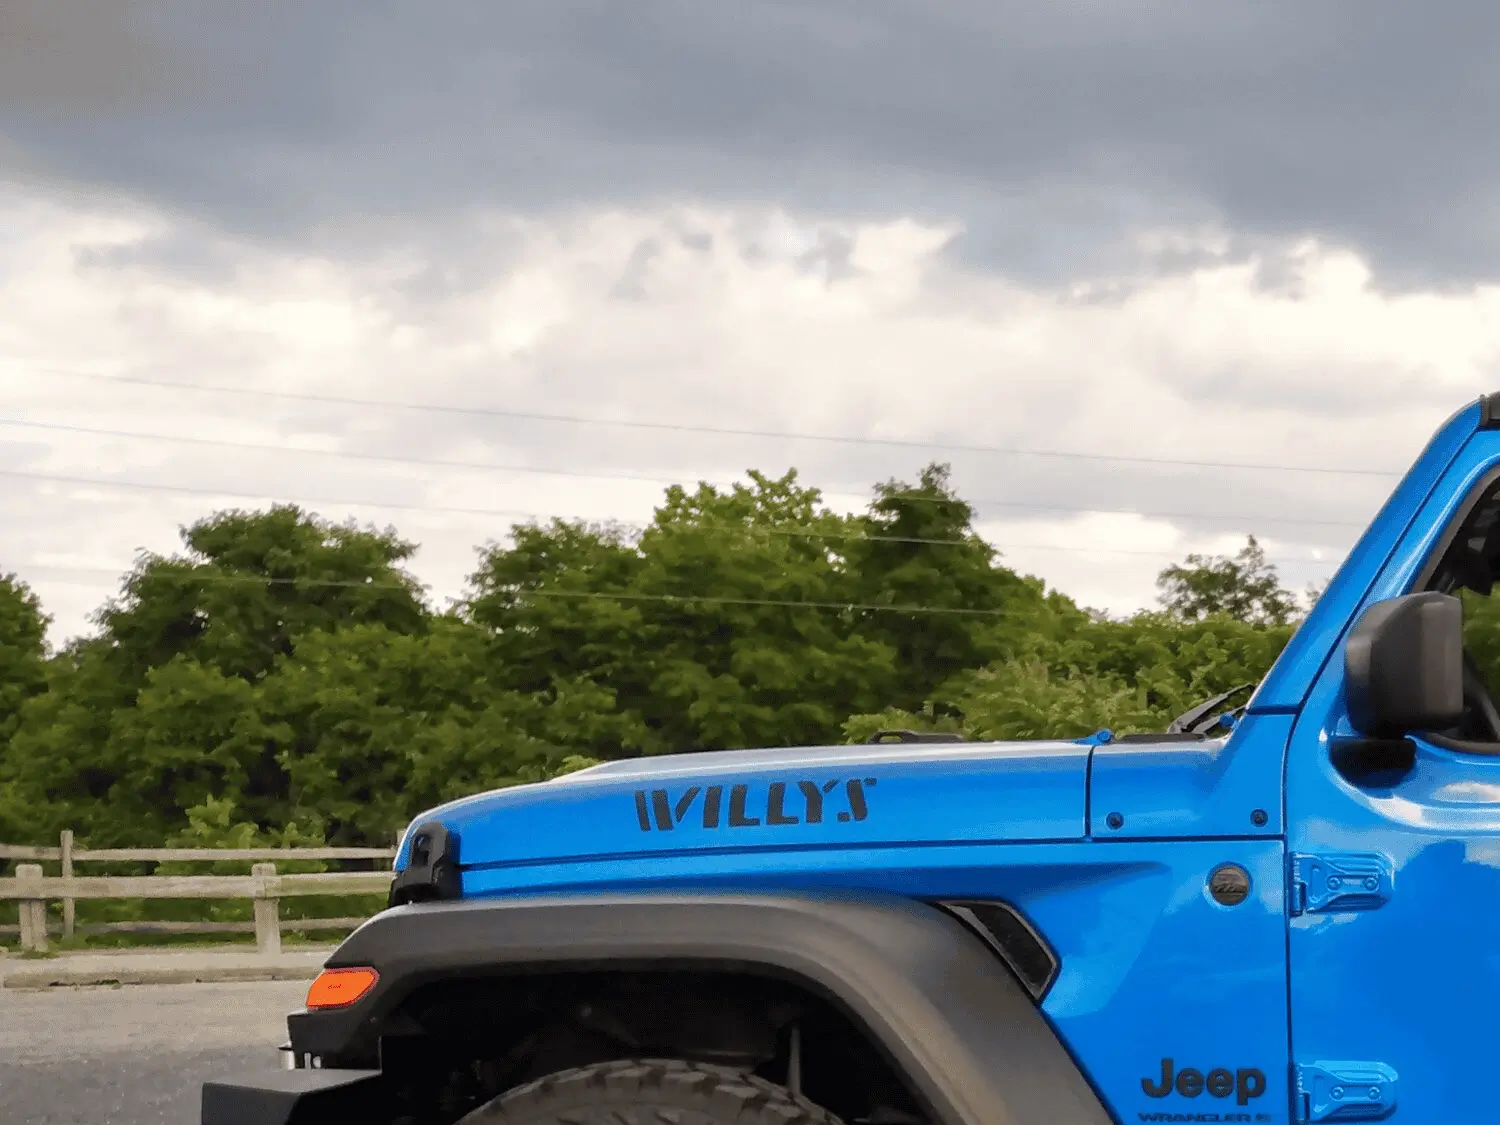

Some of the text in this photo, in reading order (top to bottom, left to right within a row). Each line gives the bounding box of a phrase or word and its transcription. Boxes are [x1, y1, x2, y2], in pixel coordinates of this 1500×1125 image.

[634, 777, 878, 832] WILLYS
[1140, 1057, 1267, 1106] Jeep
[1137, 1112, 1251, 1123] WRANGLER
